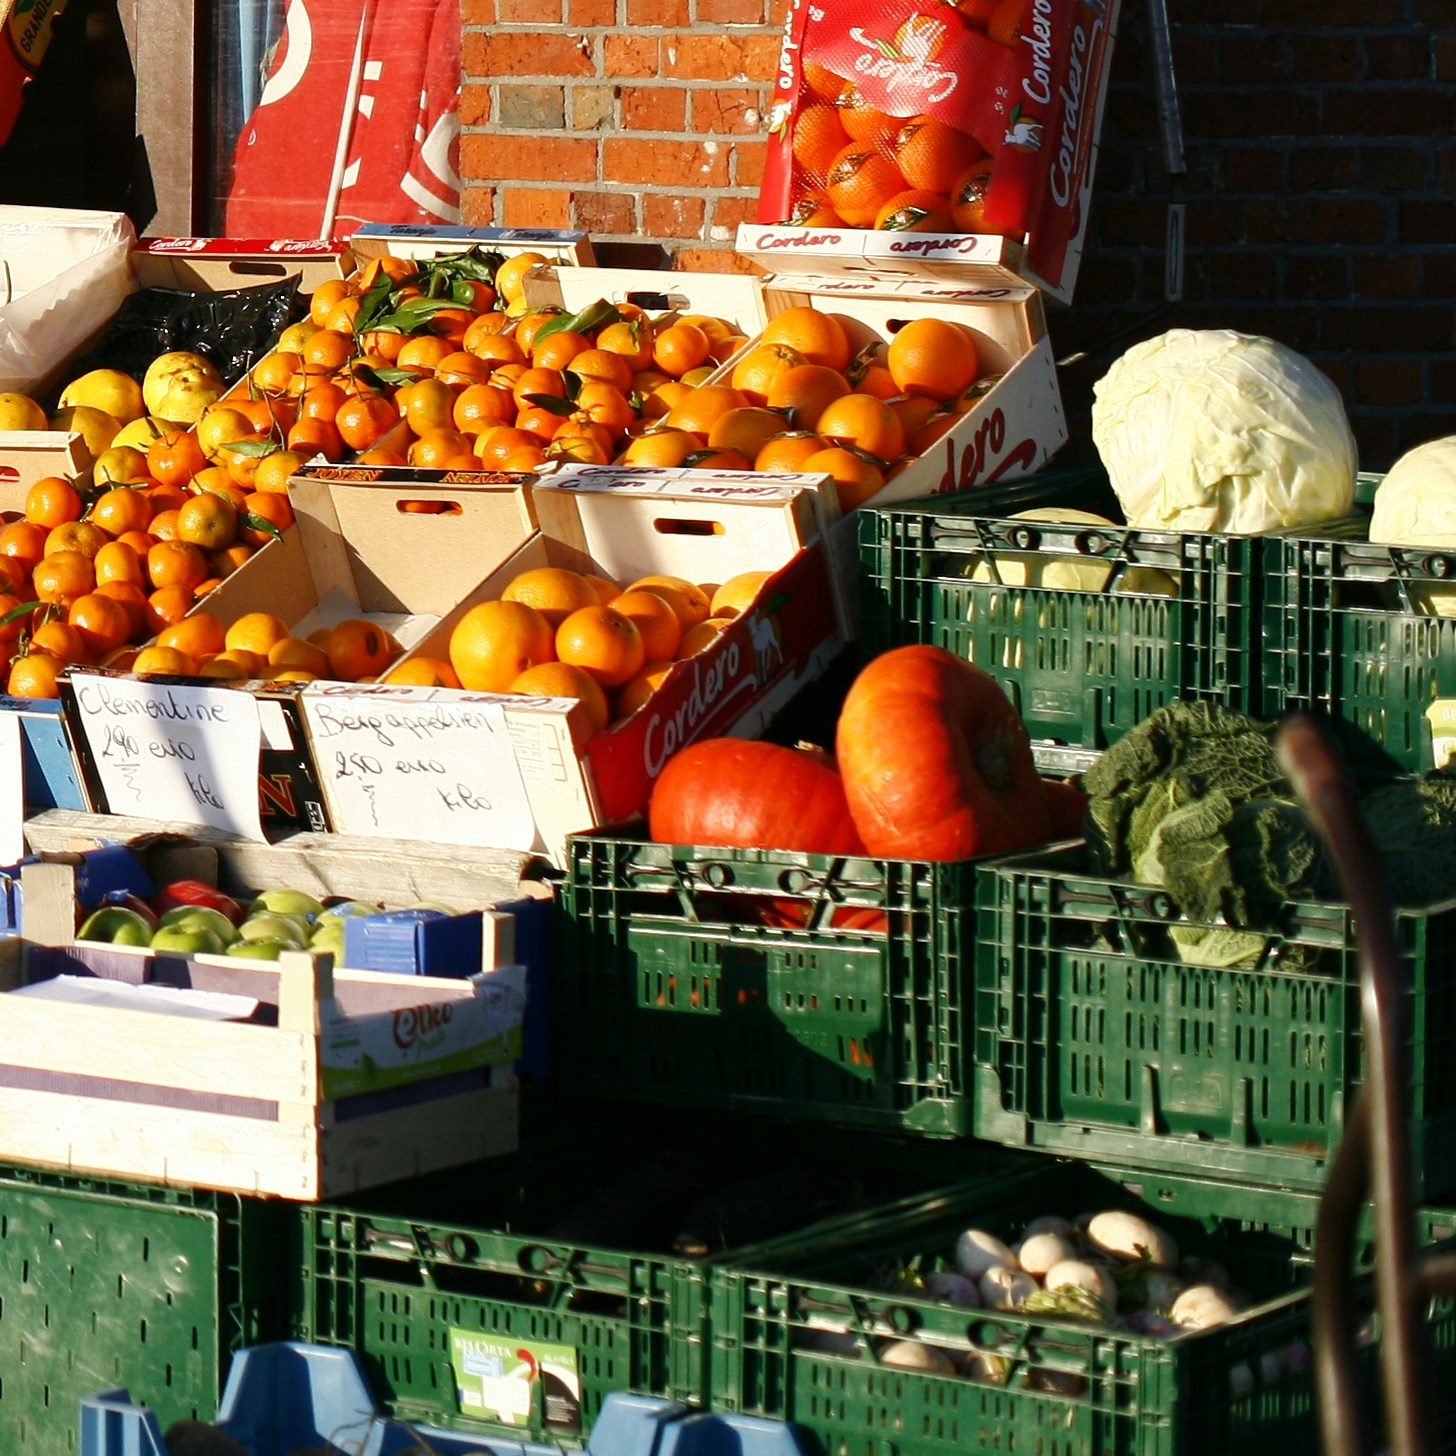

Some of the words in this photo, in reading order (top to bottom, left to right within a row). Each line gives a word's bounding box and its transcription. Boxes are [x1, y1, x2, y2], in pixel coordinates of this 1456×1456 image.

[1049, 24, 1086, 207] Cordero
[755, 231, 842, 251] Cordero
[79, 683, 231, 724] Clementine
[643, 642, 741, 780] Cordero
[149, 739, 196, 762] euro
[394, 757, 447, 775] euro
